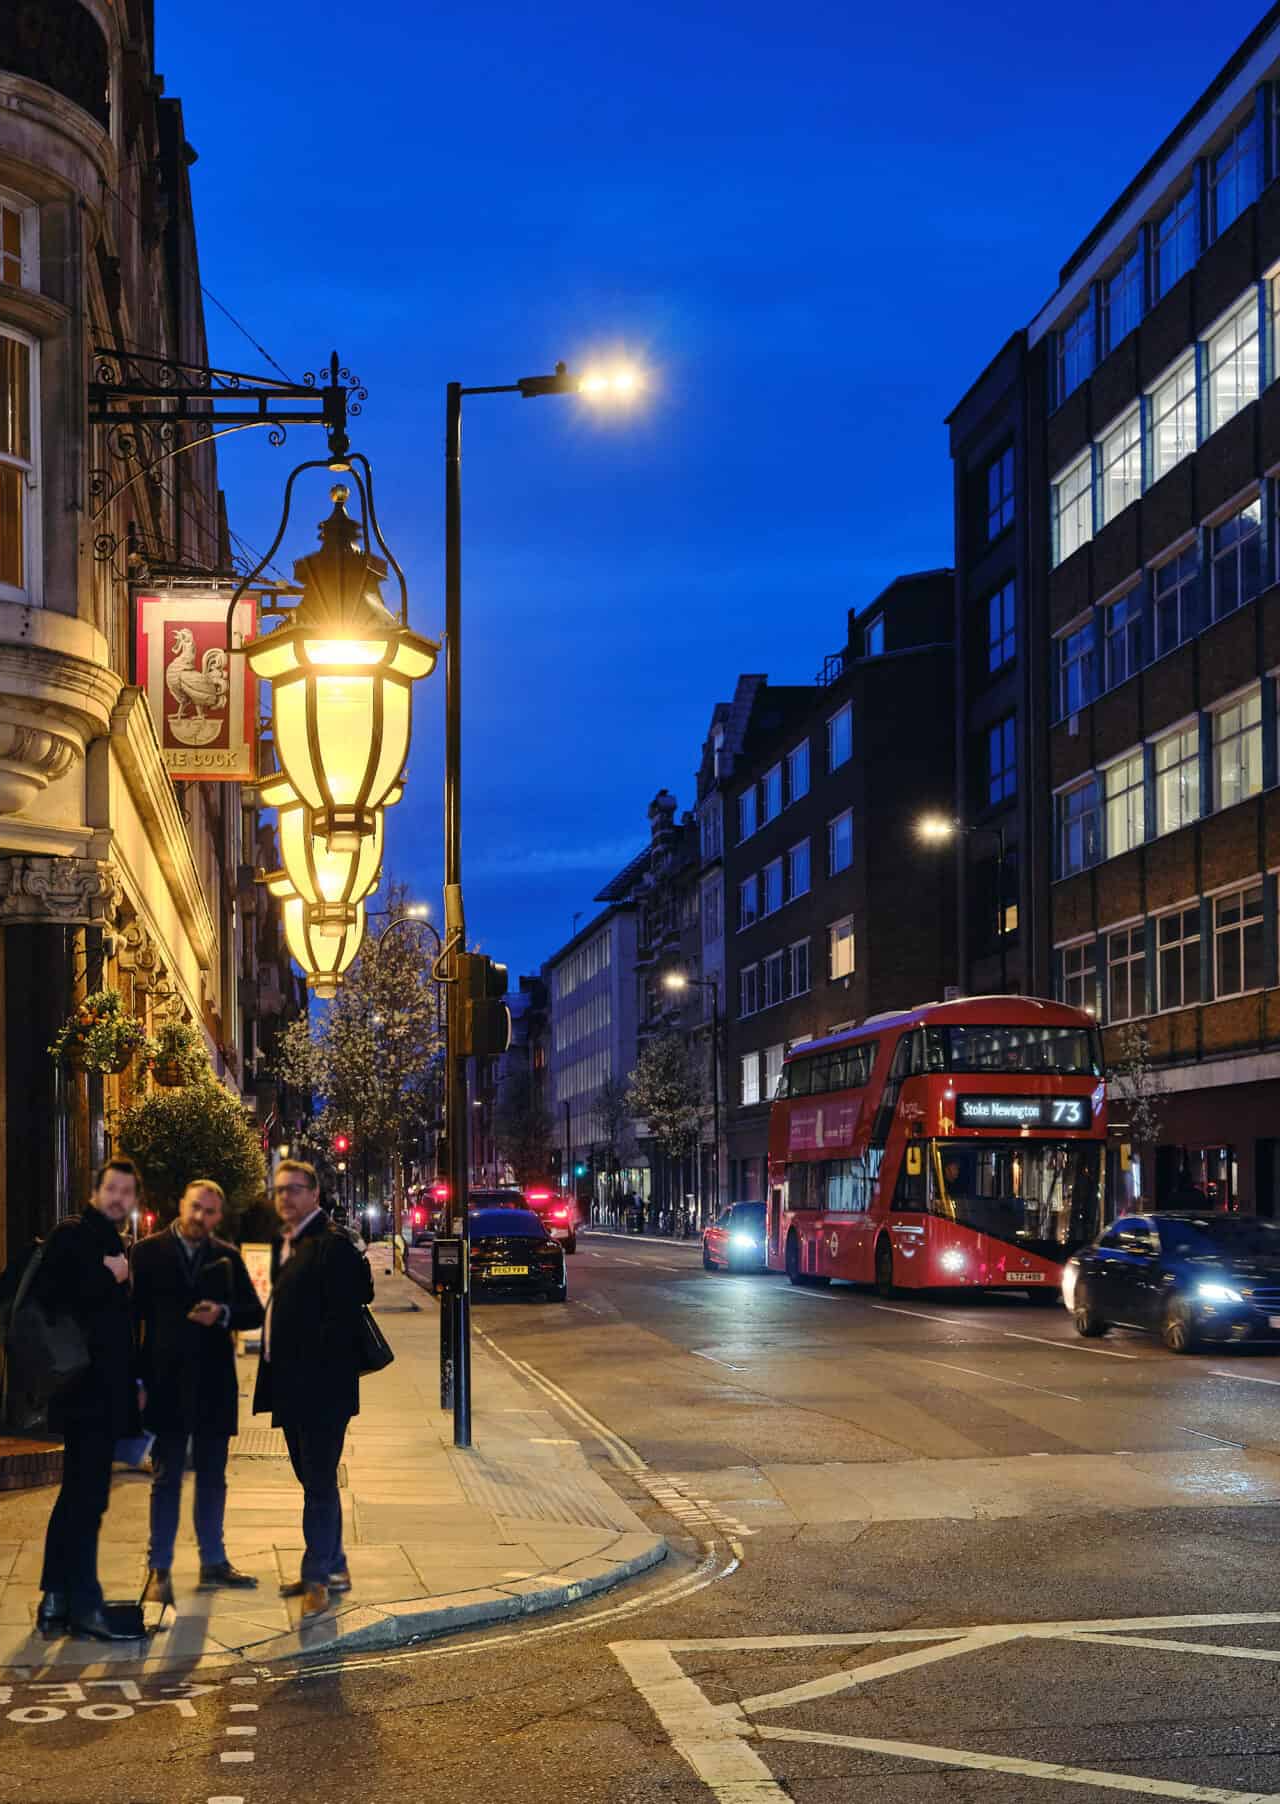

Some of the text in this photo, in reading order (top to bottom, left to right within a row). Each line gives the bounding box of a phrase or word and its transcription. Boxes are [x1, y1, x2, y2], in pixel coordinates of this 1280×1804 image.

[166, 752, 238, 768] HE COCK
[962, 1101, 1081, 1122] Stoke Newington 73
